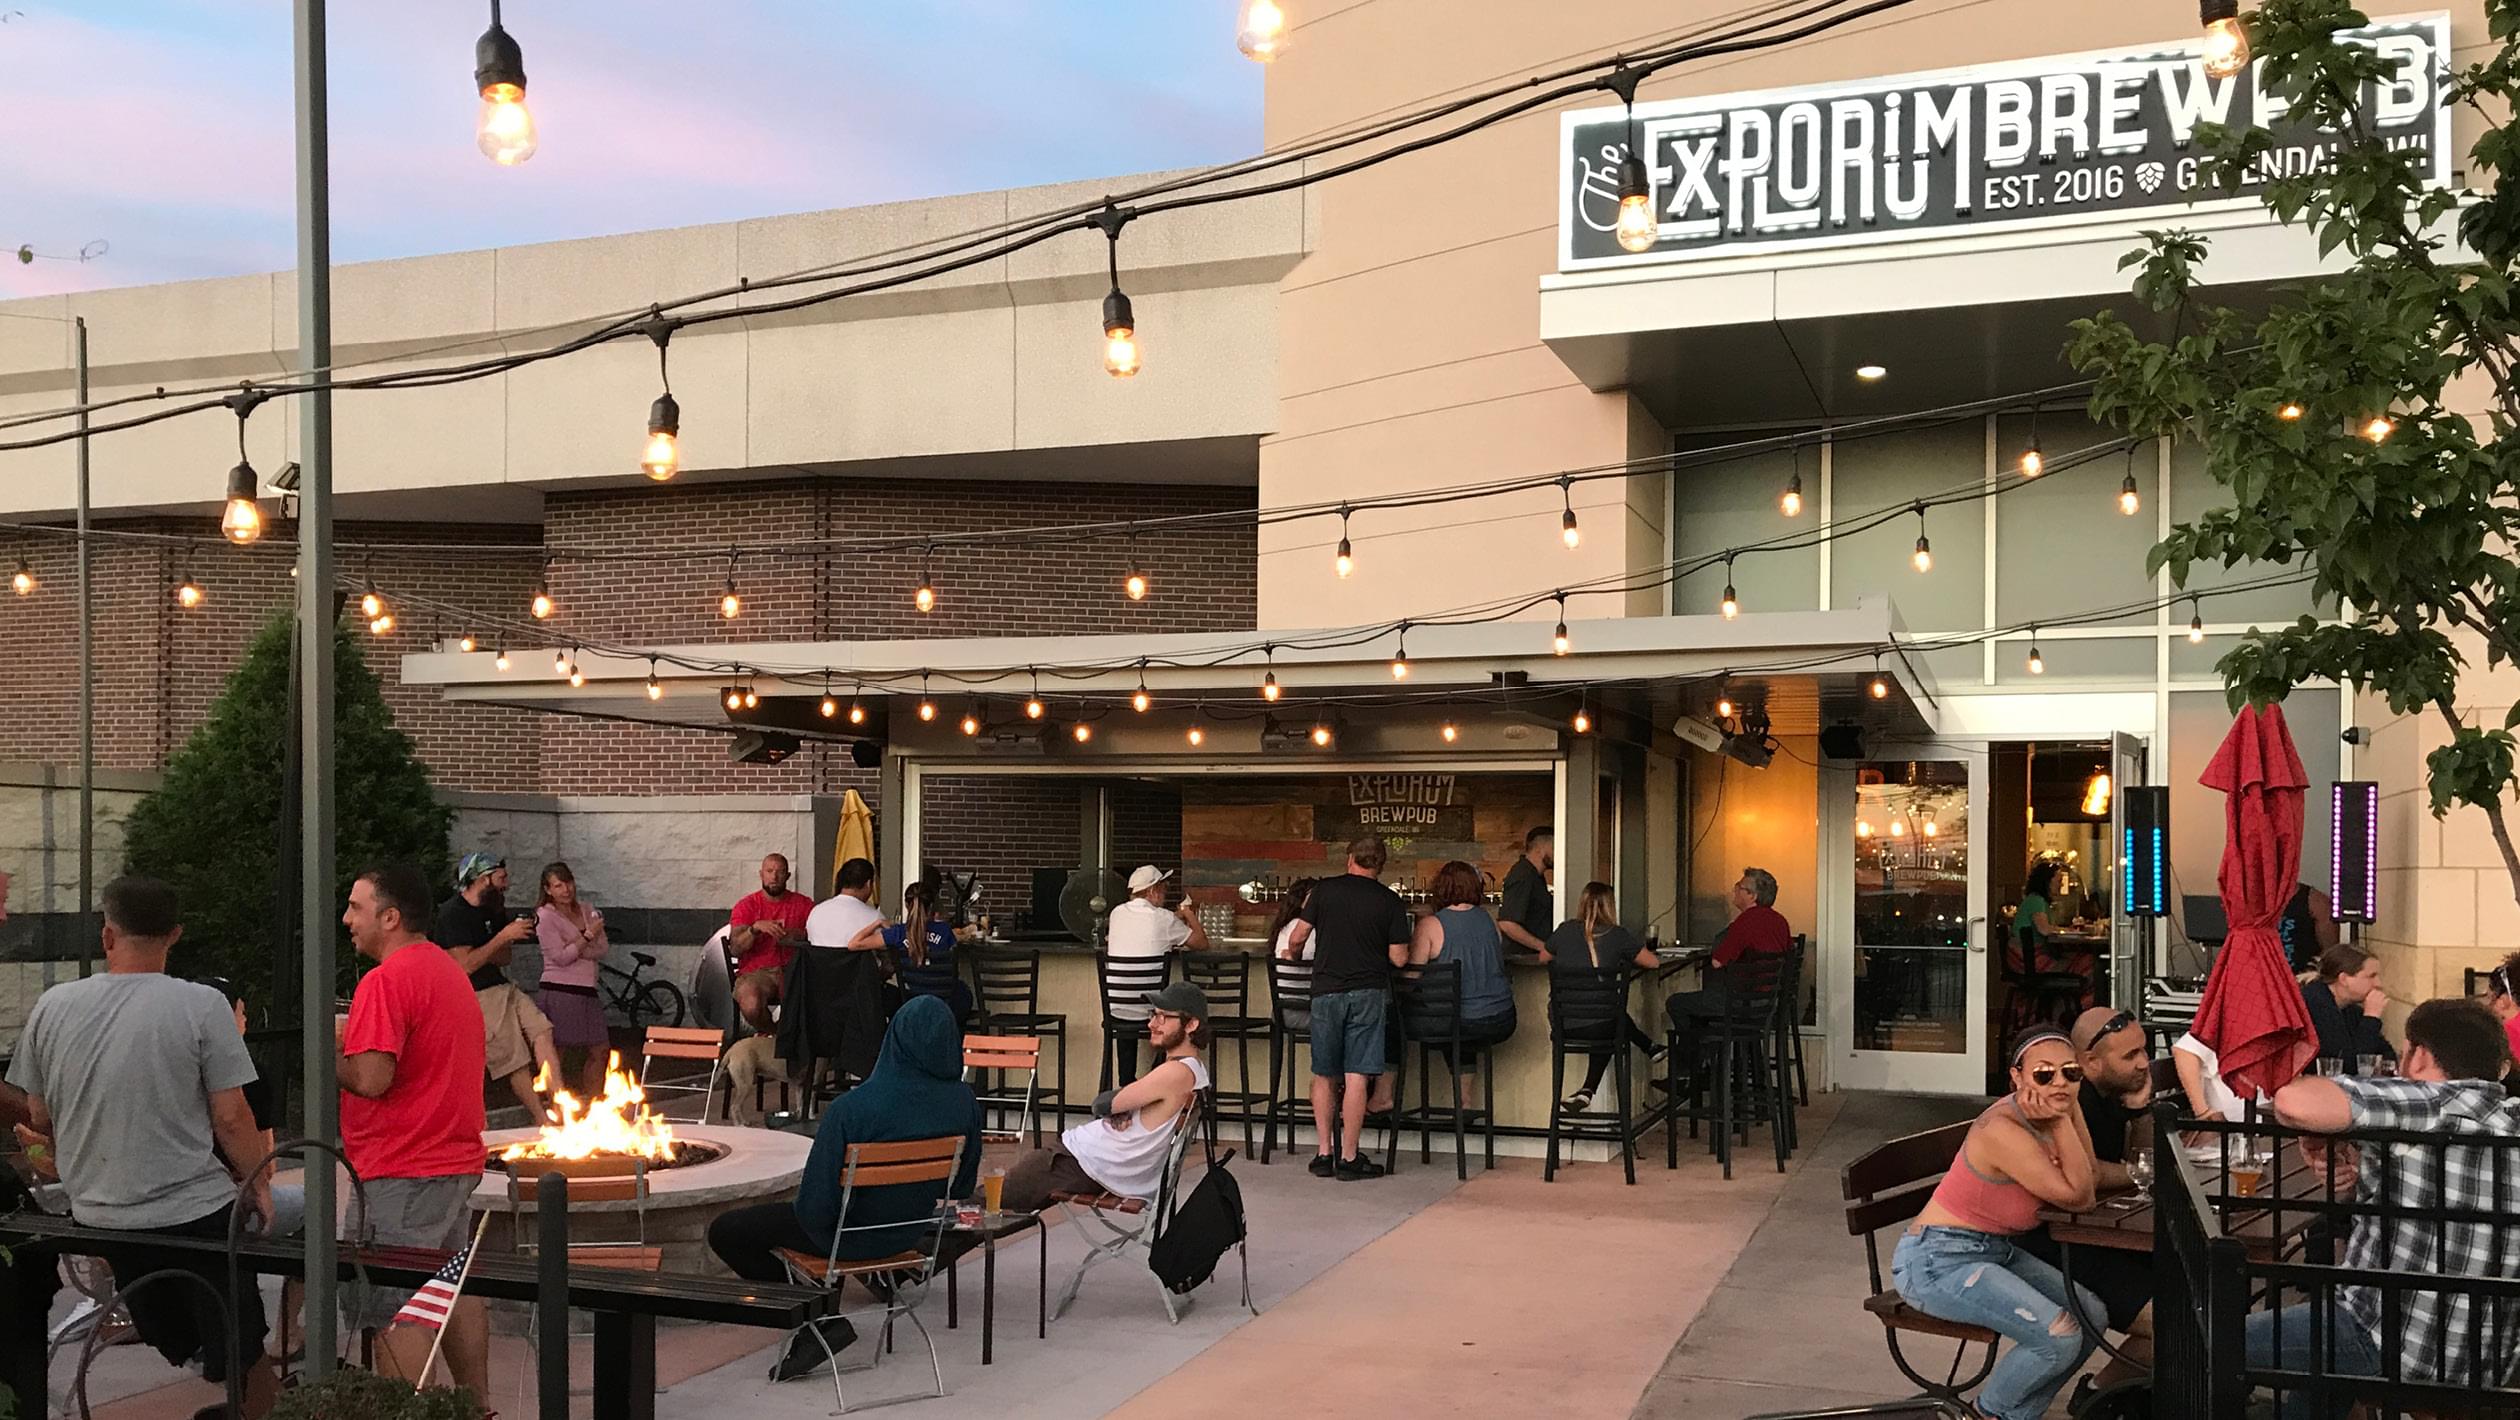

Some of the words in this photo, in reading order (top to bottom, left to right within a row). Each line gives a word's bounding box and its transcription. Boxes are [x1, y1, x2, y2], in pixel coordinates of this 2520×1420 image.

[1984, 34, 2431, 168] BREWPB
[1984, 173, 2045, 210] EST.
[2054, 164, 2124, 204] 2016
[1360, 806, 1437, 824] BREWPUB
